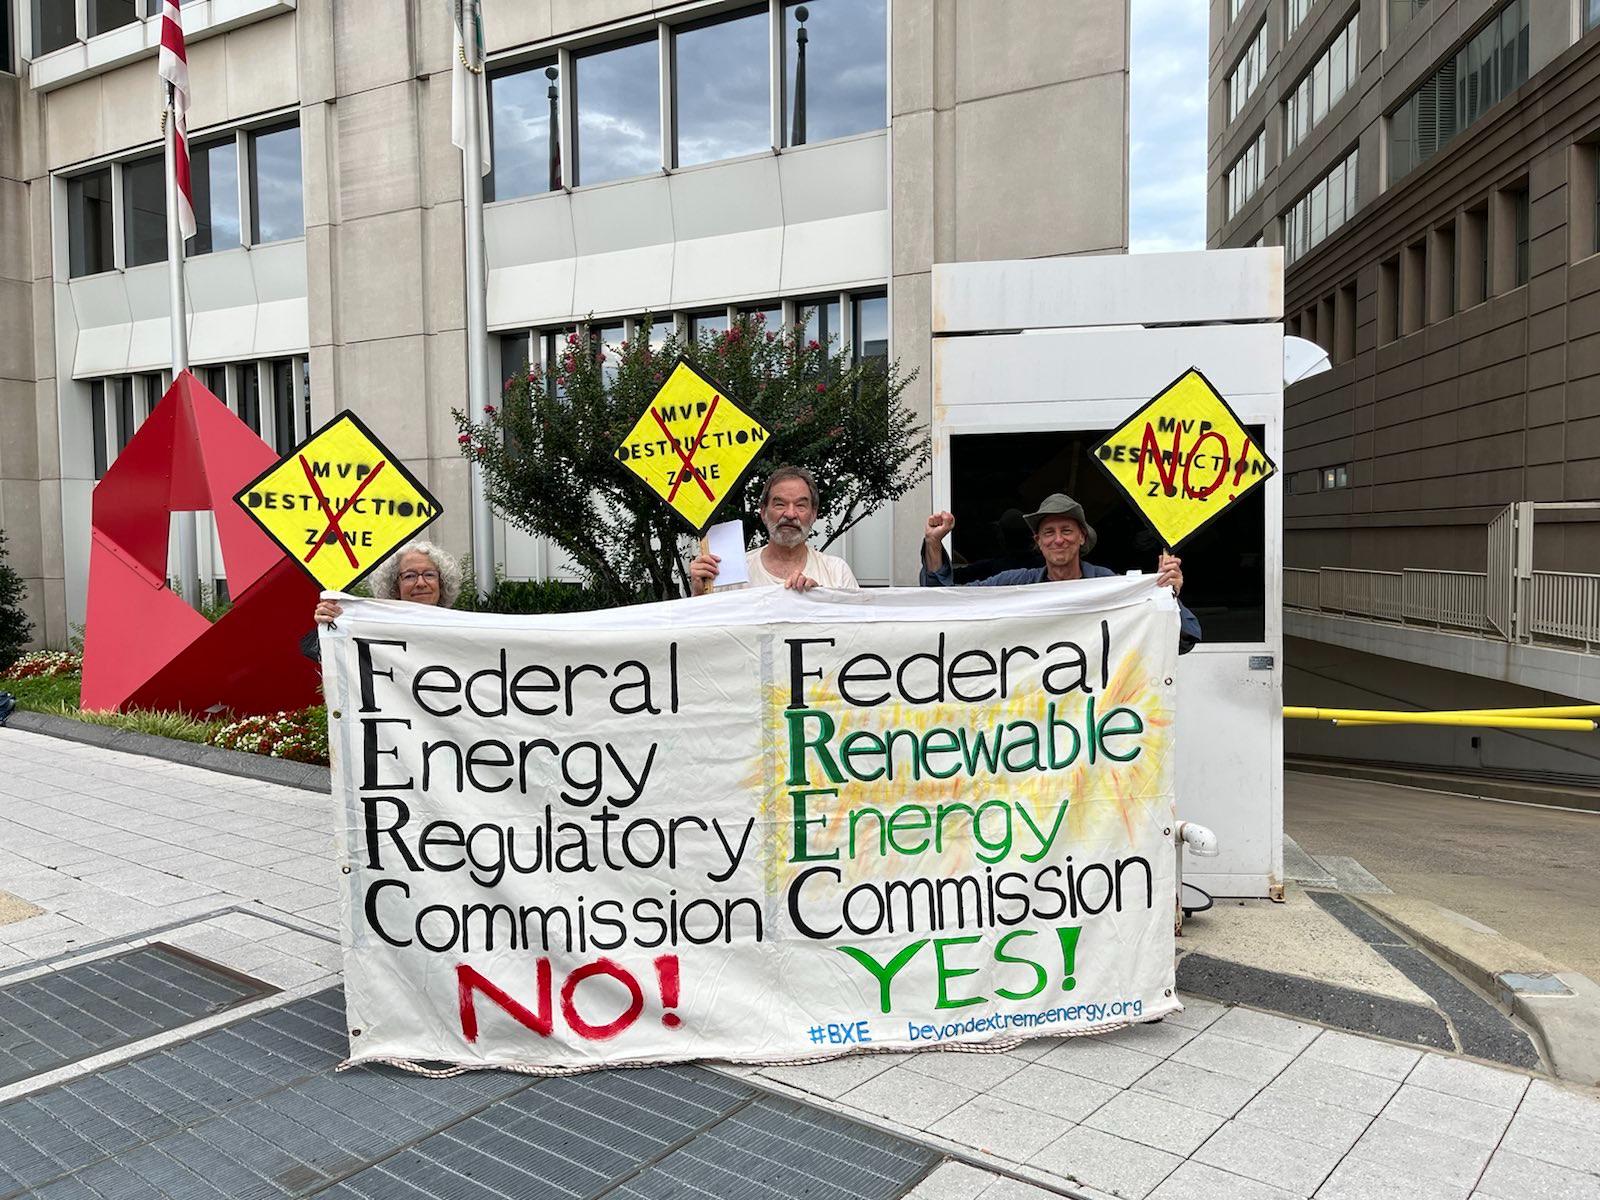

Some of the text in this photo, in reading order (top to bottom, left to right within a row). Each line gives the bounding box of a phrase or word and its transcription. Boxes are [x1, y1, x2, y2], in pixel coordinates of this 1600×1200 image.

[660, 402, 708, 423] MVP
[1158, 416, 1213, 436] MVP
[312, 461, 371, 481] MVP
[1136, 421, 1252, 501] NO!
[352, 636, 679, 718] Federal
[784, 620, 1110, 710] Federal
[359, 718, 658, 808] Energy
[784, 696, 1144, 787] Renewable
[360, 796, 756, 888] Regulatory
[788, 788, 1070, 865] Energy
[364, 878, 765, 953] Commission
[787, 855, 1153, 940] Commission
[454, 953, 685, 1044] NO!
[836, 926, 1083, 1015] YES!
[807, 1000, 1143, 1045] #BXE beyondextremeenergy.org
